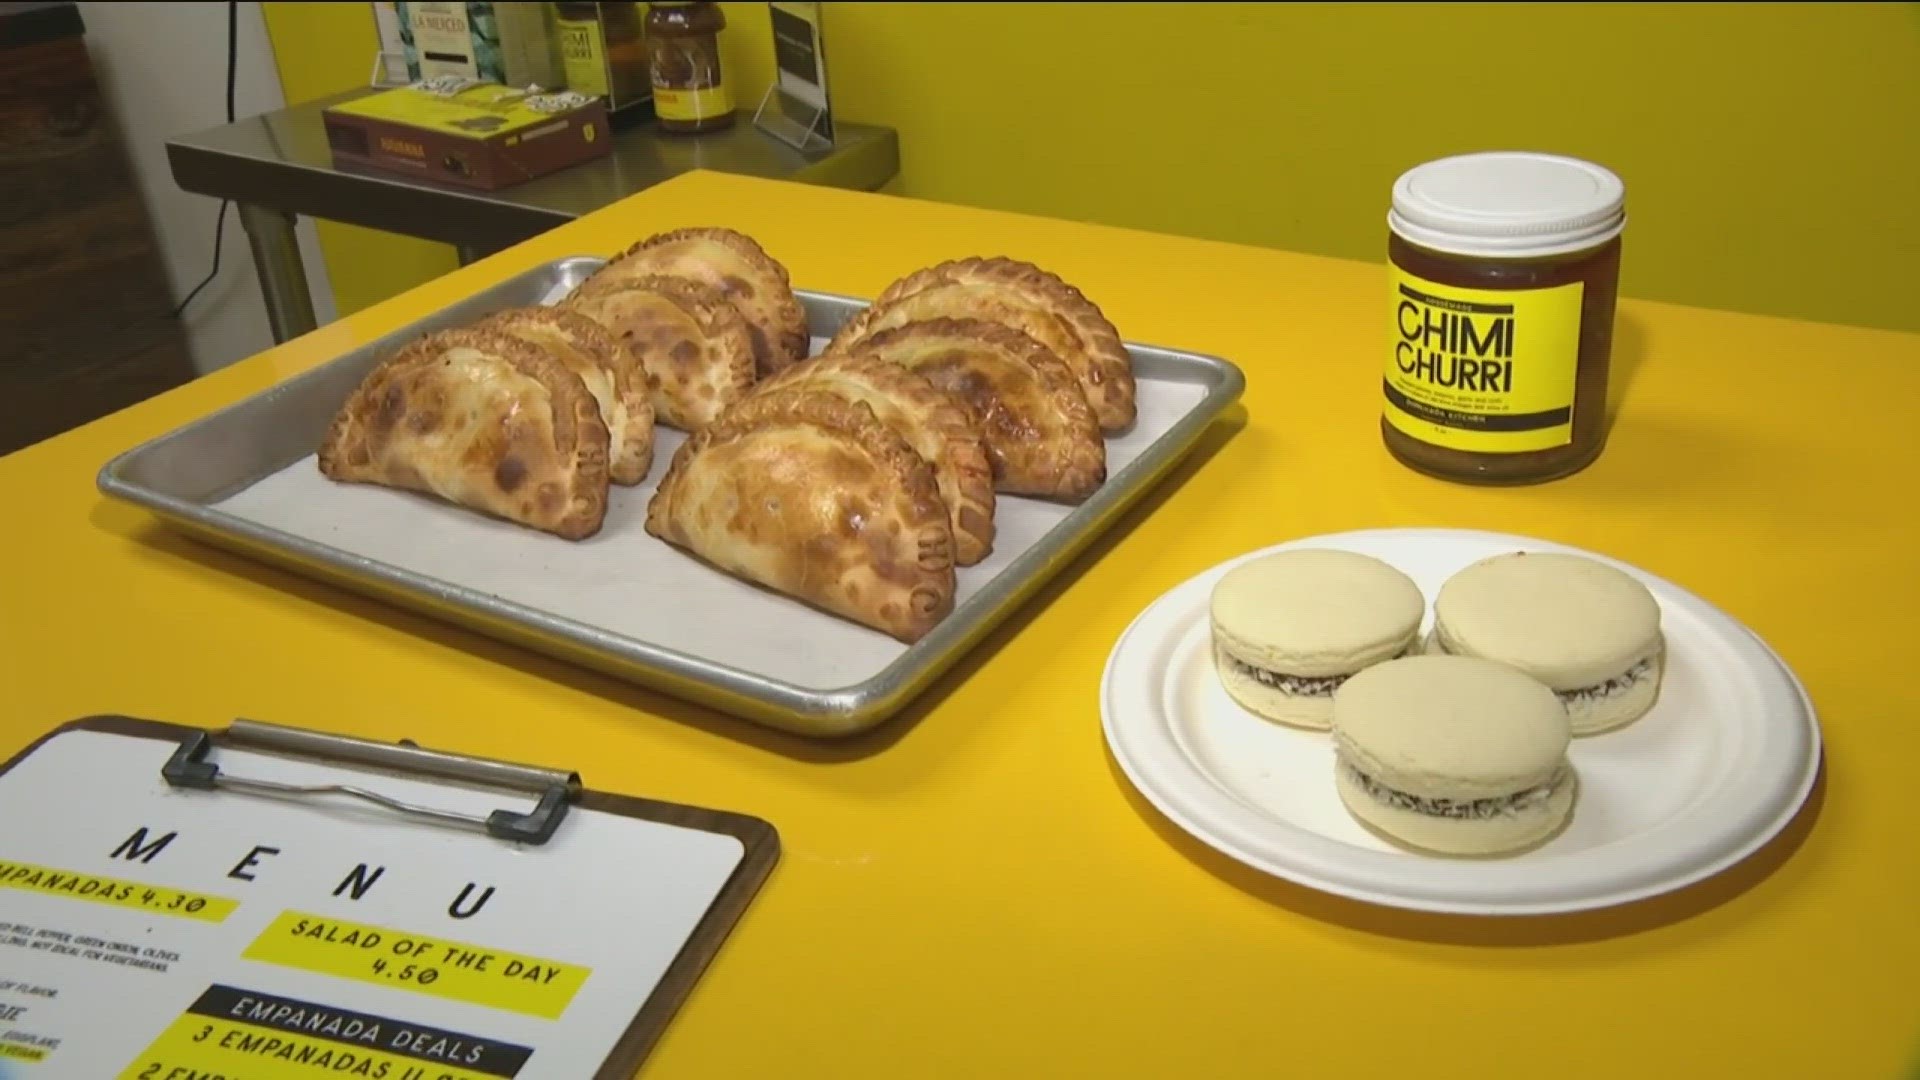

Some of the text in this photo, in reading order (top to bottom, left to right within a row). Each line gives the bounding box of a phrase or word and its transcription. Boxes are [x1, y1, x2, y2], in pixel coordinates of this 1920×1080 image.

[1398, 300, 1515, 358] CHIMI
[1396, 341, 1513, 393] CHURRI
[141, 888, 207, 913] 4.30
[291, 919, 562, 985] SALAD OF THE DAY
[371, 958, 440, 985] 4.50
[192, 1025, 214, 1043] 3
[219, 1029, 392, 1079] EMPANADAS
[230, 997, 485, 1065] EMPANADA DEALS
[137, 1062, 162, 1080] 2
